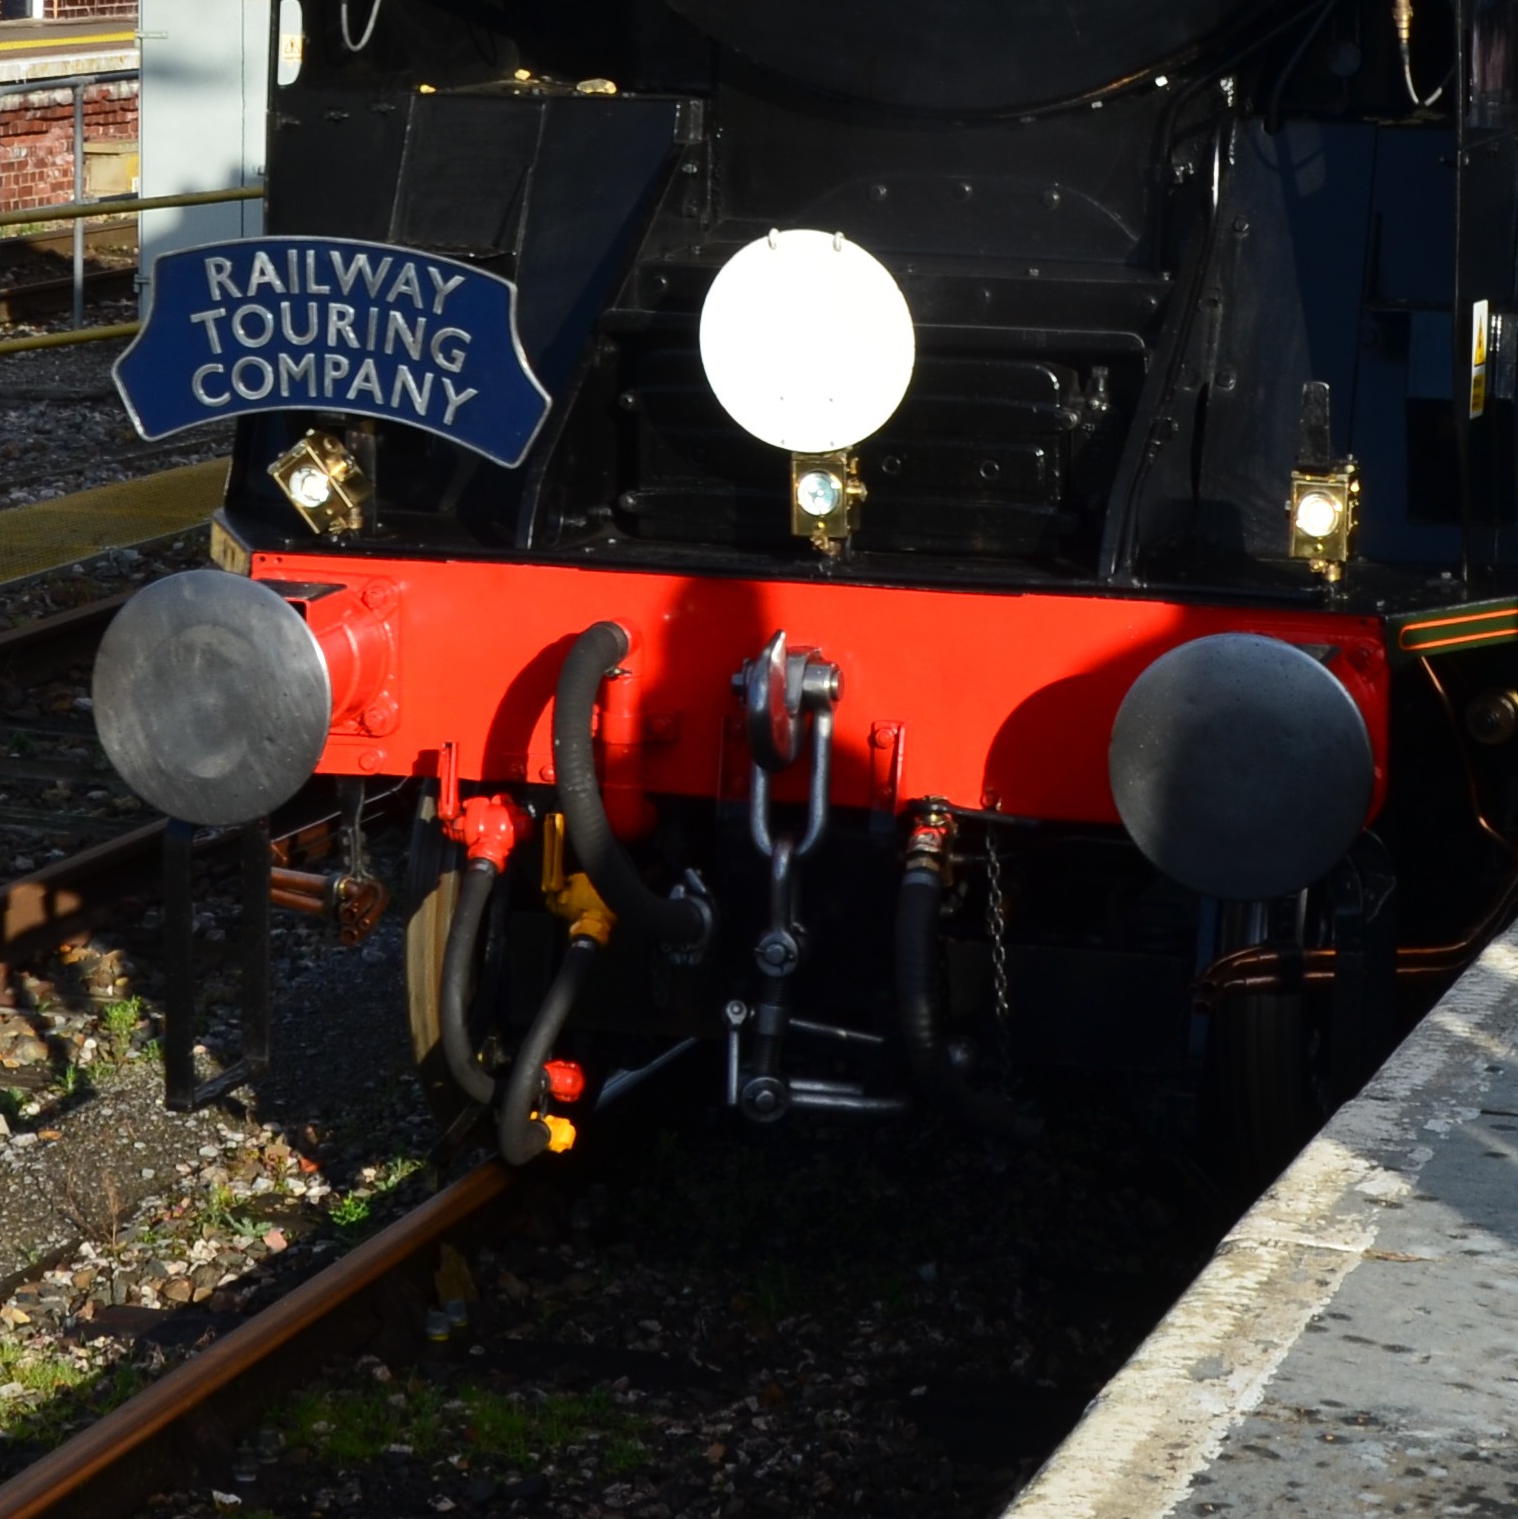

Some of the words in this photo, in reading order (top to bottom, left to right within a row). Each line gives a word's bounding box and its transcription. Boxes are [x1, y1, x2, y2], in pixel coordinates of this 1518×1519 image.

[205, 249, 466, 315] RAILWAY
[189, 301, 473, 374] TOURING
[192, 353, 479, 426] COMPANY
